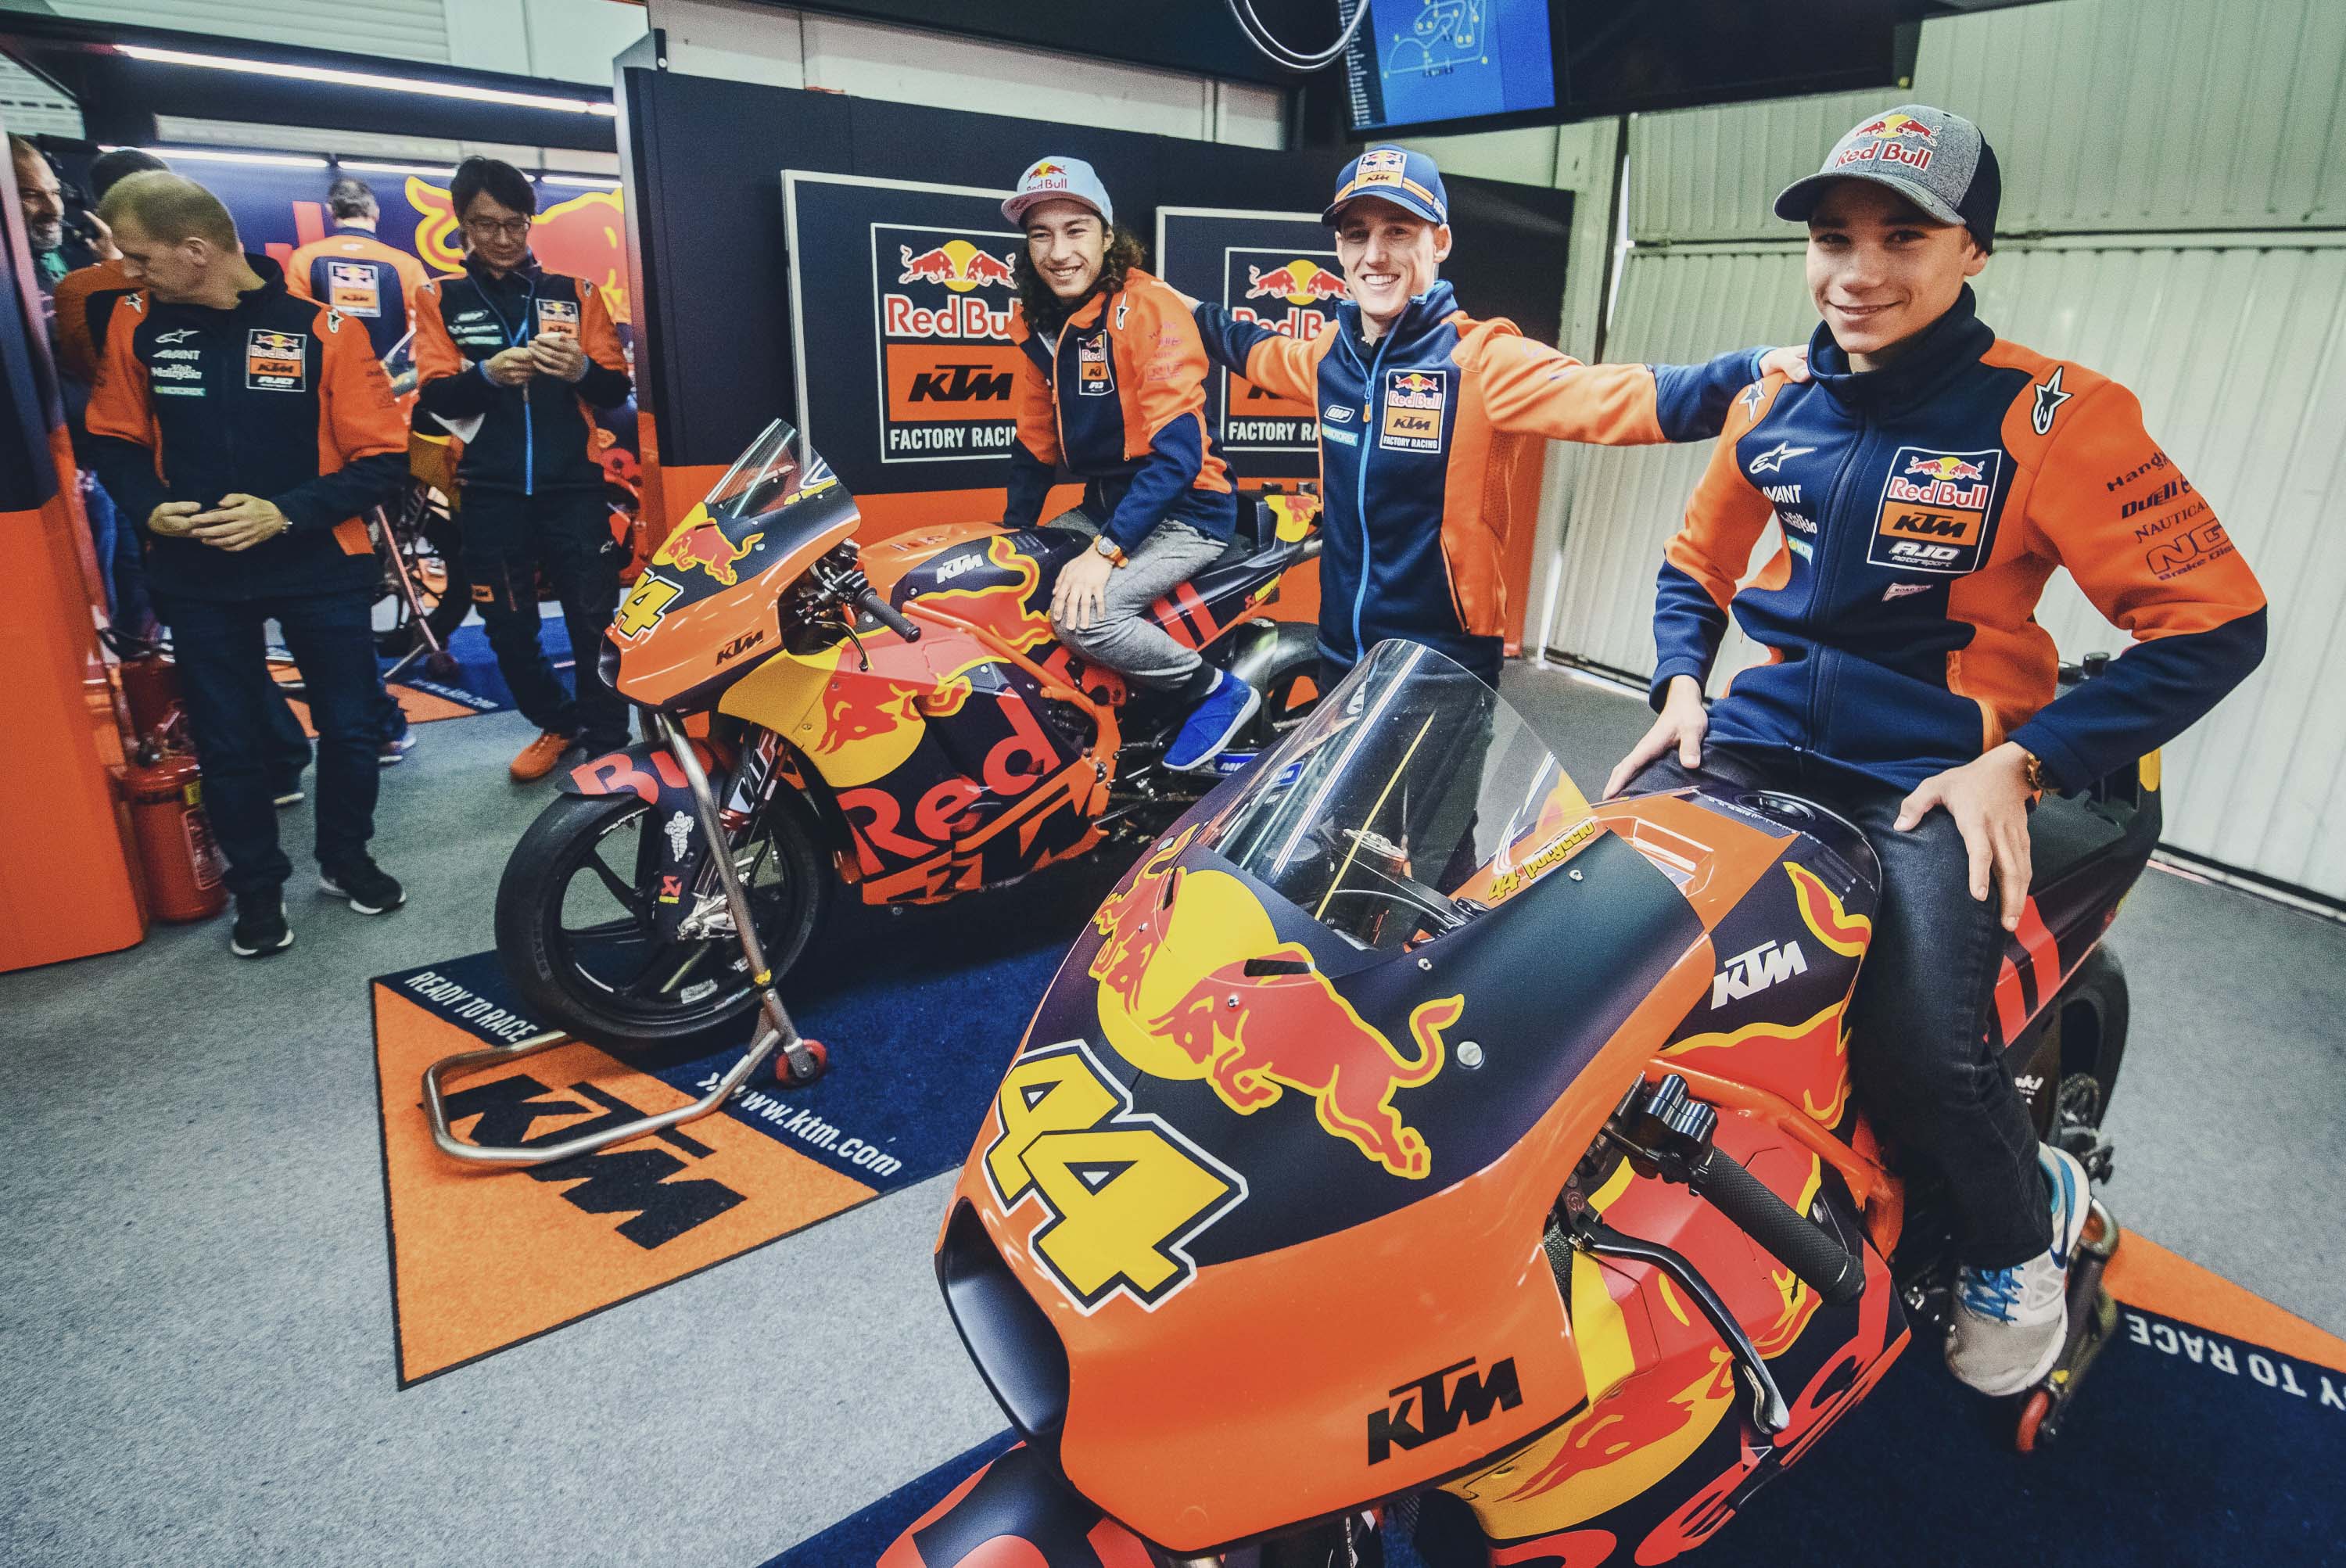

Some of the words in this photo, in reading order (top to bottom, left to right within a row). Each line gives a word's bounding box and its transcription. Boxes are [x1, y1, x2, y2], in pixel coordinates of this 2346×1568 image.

[1835, 141, 1881, 170] Red
[1881, 142, 1934, 173] Bull
[1045, 178, 1067, 189] Bull
[884, 294, 961, 337] Red
[908, 364, 1014, 402] KTM
[1388, 390, 1415, 407] Red
[1415, 391, 1443, 410] Bull
[890, 428, 966, 450] FACTORY
[1229, 422, 1297, 441] FACTORY
[1393, 414, 1431, 431] KTM
[1383, 436, 1411, 447] FACTORY
[1411, 437, 1438, 449] RACING
[1887, 476, 1940, 504] Red
[1935, 481, 1989, 510] Bull
[1892, 511, 1968, 538] KTM
[1889, 540, 1960, 561] AJO
[936, 554, 985, 584] KTM
[2158, 558, 2207, 580] Brake
[716, 629, 764, 667] KTM
[836, 687, 1062, 877] Red
[1487, 868, 1521, 901] 44
[1710, 940, 1808, 1010] KTM
[404, 971, 473, 1006] READY
[454, 996, 493, 1018] TO
[474, 1008, 539, 1042] RACE
[419, 1073, 748, 1250] KTM
[984, 1038, 1250, 1316] 44
[2125, 1312, 2240, 1376] RACE
[2247, 1353, 2308, 1398] TO
[1366, 1356, 1524, 1467] KTM
